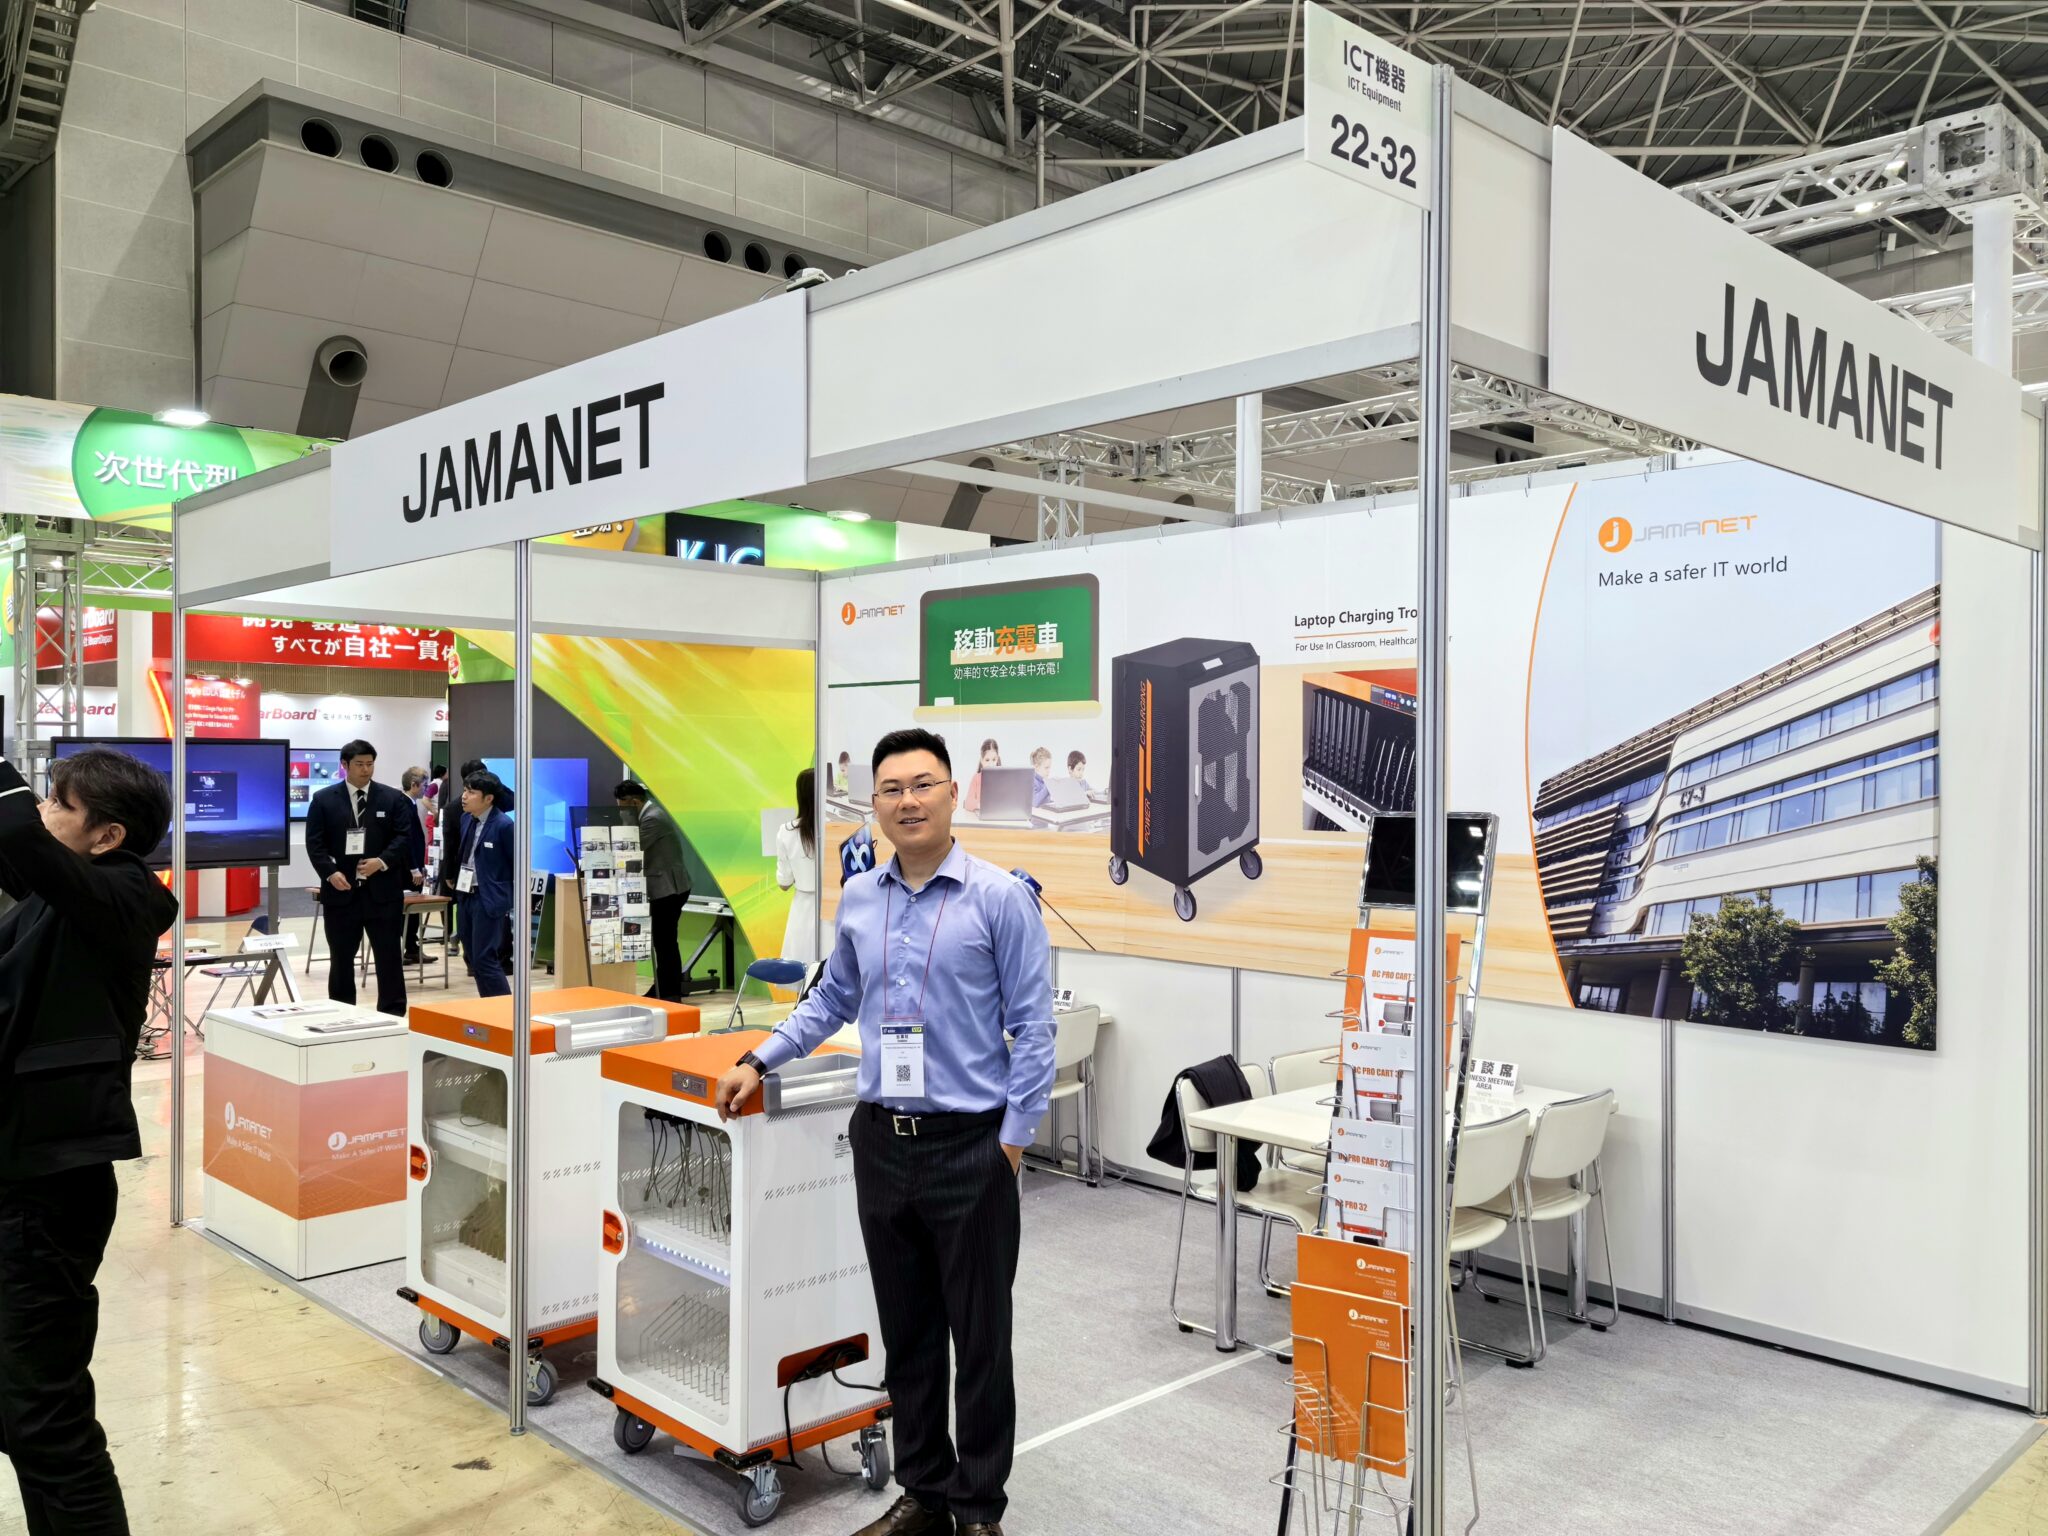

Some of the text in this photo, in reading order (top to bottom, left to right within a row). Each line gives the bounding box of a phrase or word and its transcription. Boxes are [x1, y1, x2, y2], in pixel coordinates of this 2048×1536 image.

[1343, 40, 1406, 94] ICT機器
[1347, 75, 1402, 112] ICT Equipment
[1330, 113, 1417, 189] 22-32
[1696, 282, 1953, 470] JAMANET
[94, 450, 238, 492] 次世代型
[402, 381, 665, 523] JAMANET
[1599, 555, 1788, 587] Make a safer IT world
[1294, 615, 1336, 629] Laptop
[1339, 608, 1394, 625] Charging
[953, 621, 1059, 659] 移動充電車
[1295, 643, 1308, 651] For
[1309, 642, 1324, 651] Use
[1326, 641, 1334, 650] In
[1335, 639, 1377, 649] Classroom,
[1139, 680, 1147, 746] CHARGING
[1475, 1082, 1492, 1090] AREA
